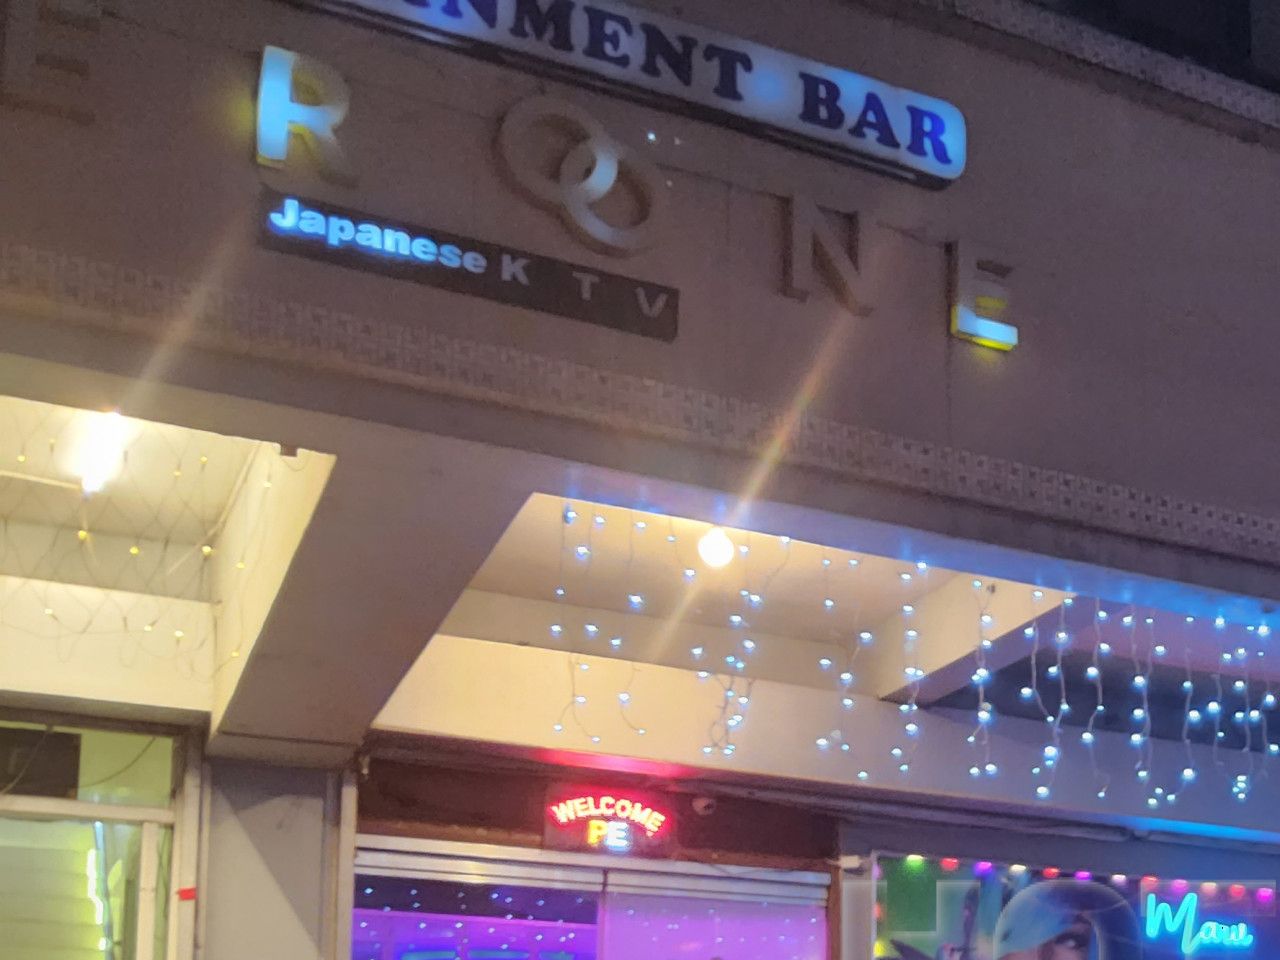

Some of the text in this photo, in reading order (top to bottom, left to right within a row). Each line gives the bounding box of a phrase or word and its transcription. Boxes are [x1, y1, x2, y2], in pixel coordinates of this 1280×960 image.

[799, 72, 952, 165] BAR
[269, 197, 488, 275] Japanese
[551, 796, 666, 837] WELCOME
